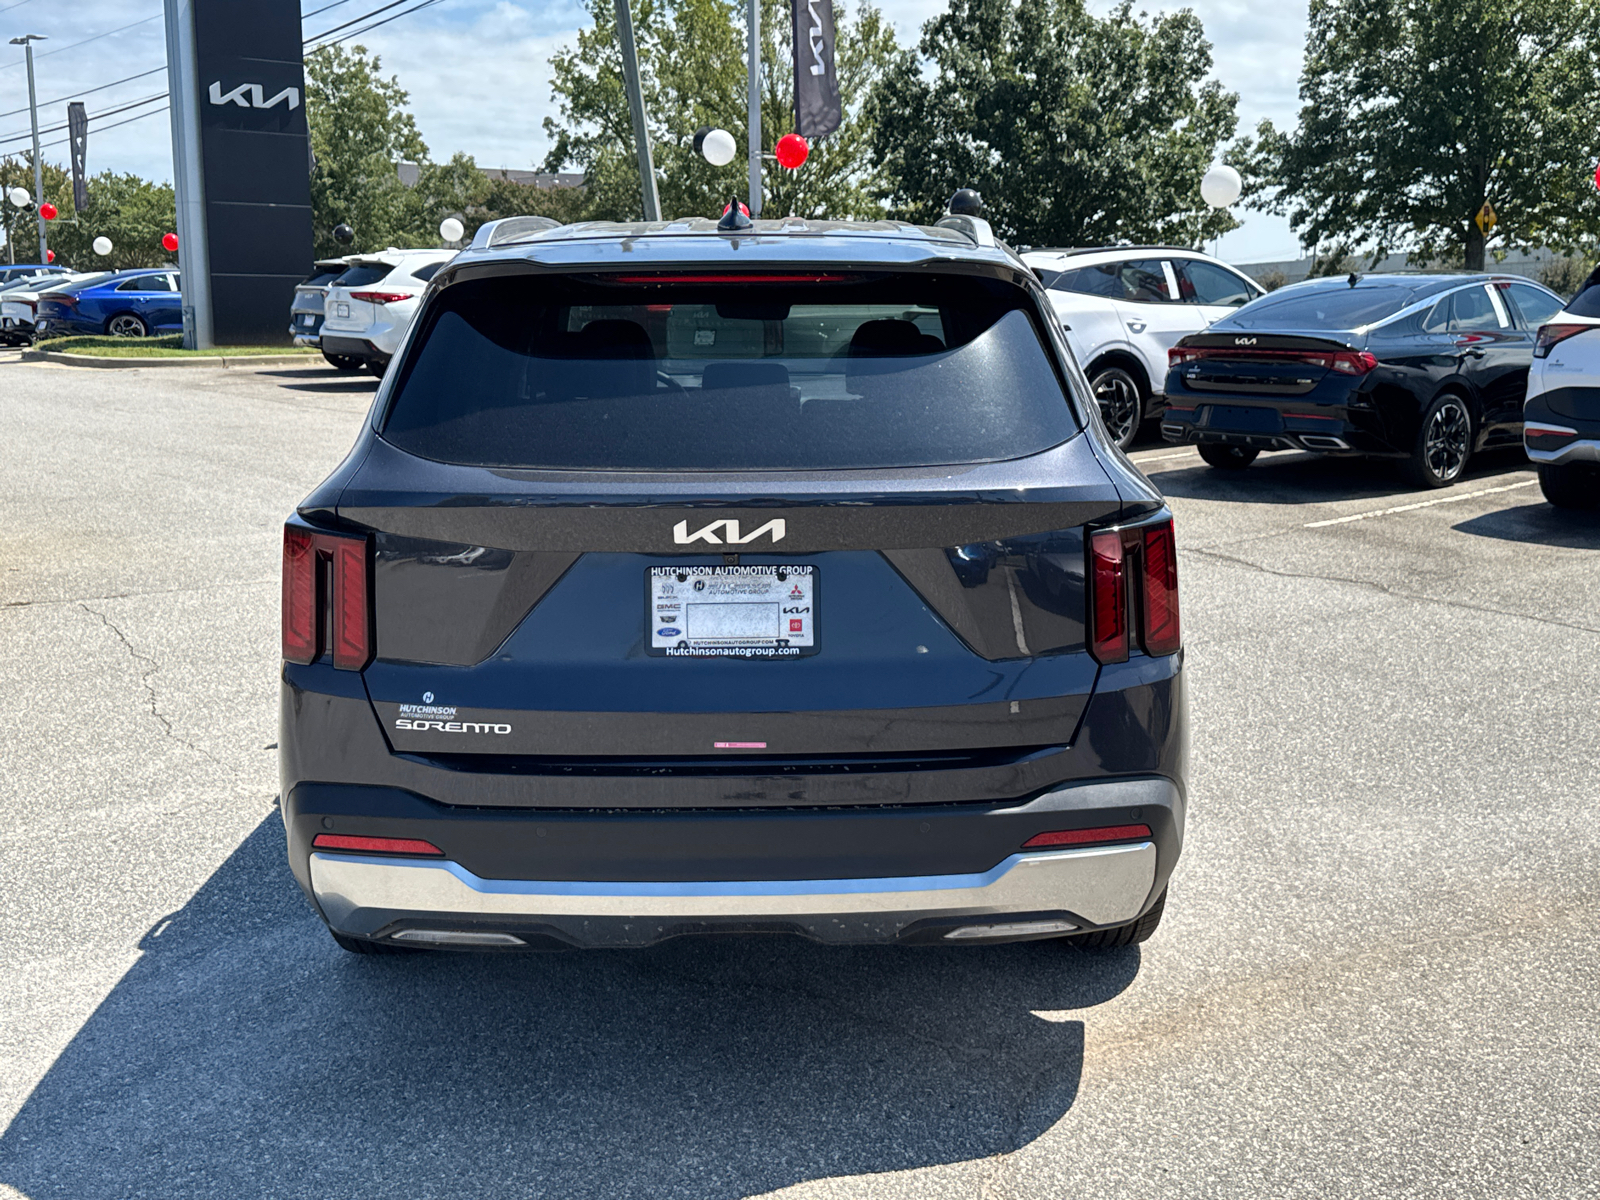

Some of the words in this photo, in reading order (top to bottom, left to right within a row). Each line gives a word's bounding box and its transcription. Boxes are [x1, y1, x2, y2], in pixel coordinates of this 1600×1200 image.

[209, 80, 300, 111] KIA
[1235, 337, 1257, 345] KIA
[673, 518, 786, 544] KIA
[651, 566, 713, 576] HUTCHINSON
[715, 566, 777, 575] AUTOMOTIVE
[779, 565, 813, 575] GROUP
[783, 606, 810, 614] KIA
[666, 647, 800, 657] Hutchinsonautogroup.com
[399, 704, 457, 715] HUTCHINSON
[395, 719, 512, 735] SORENTO
